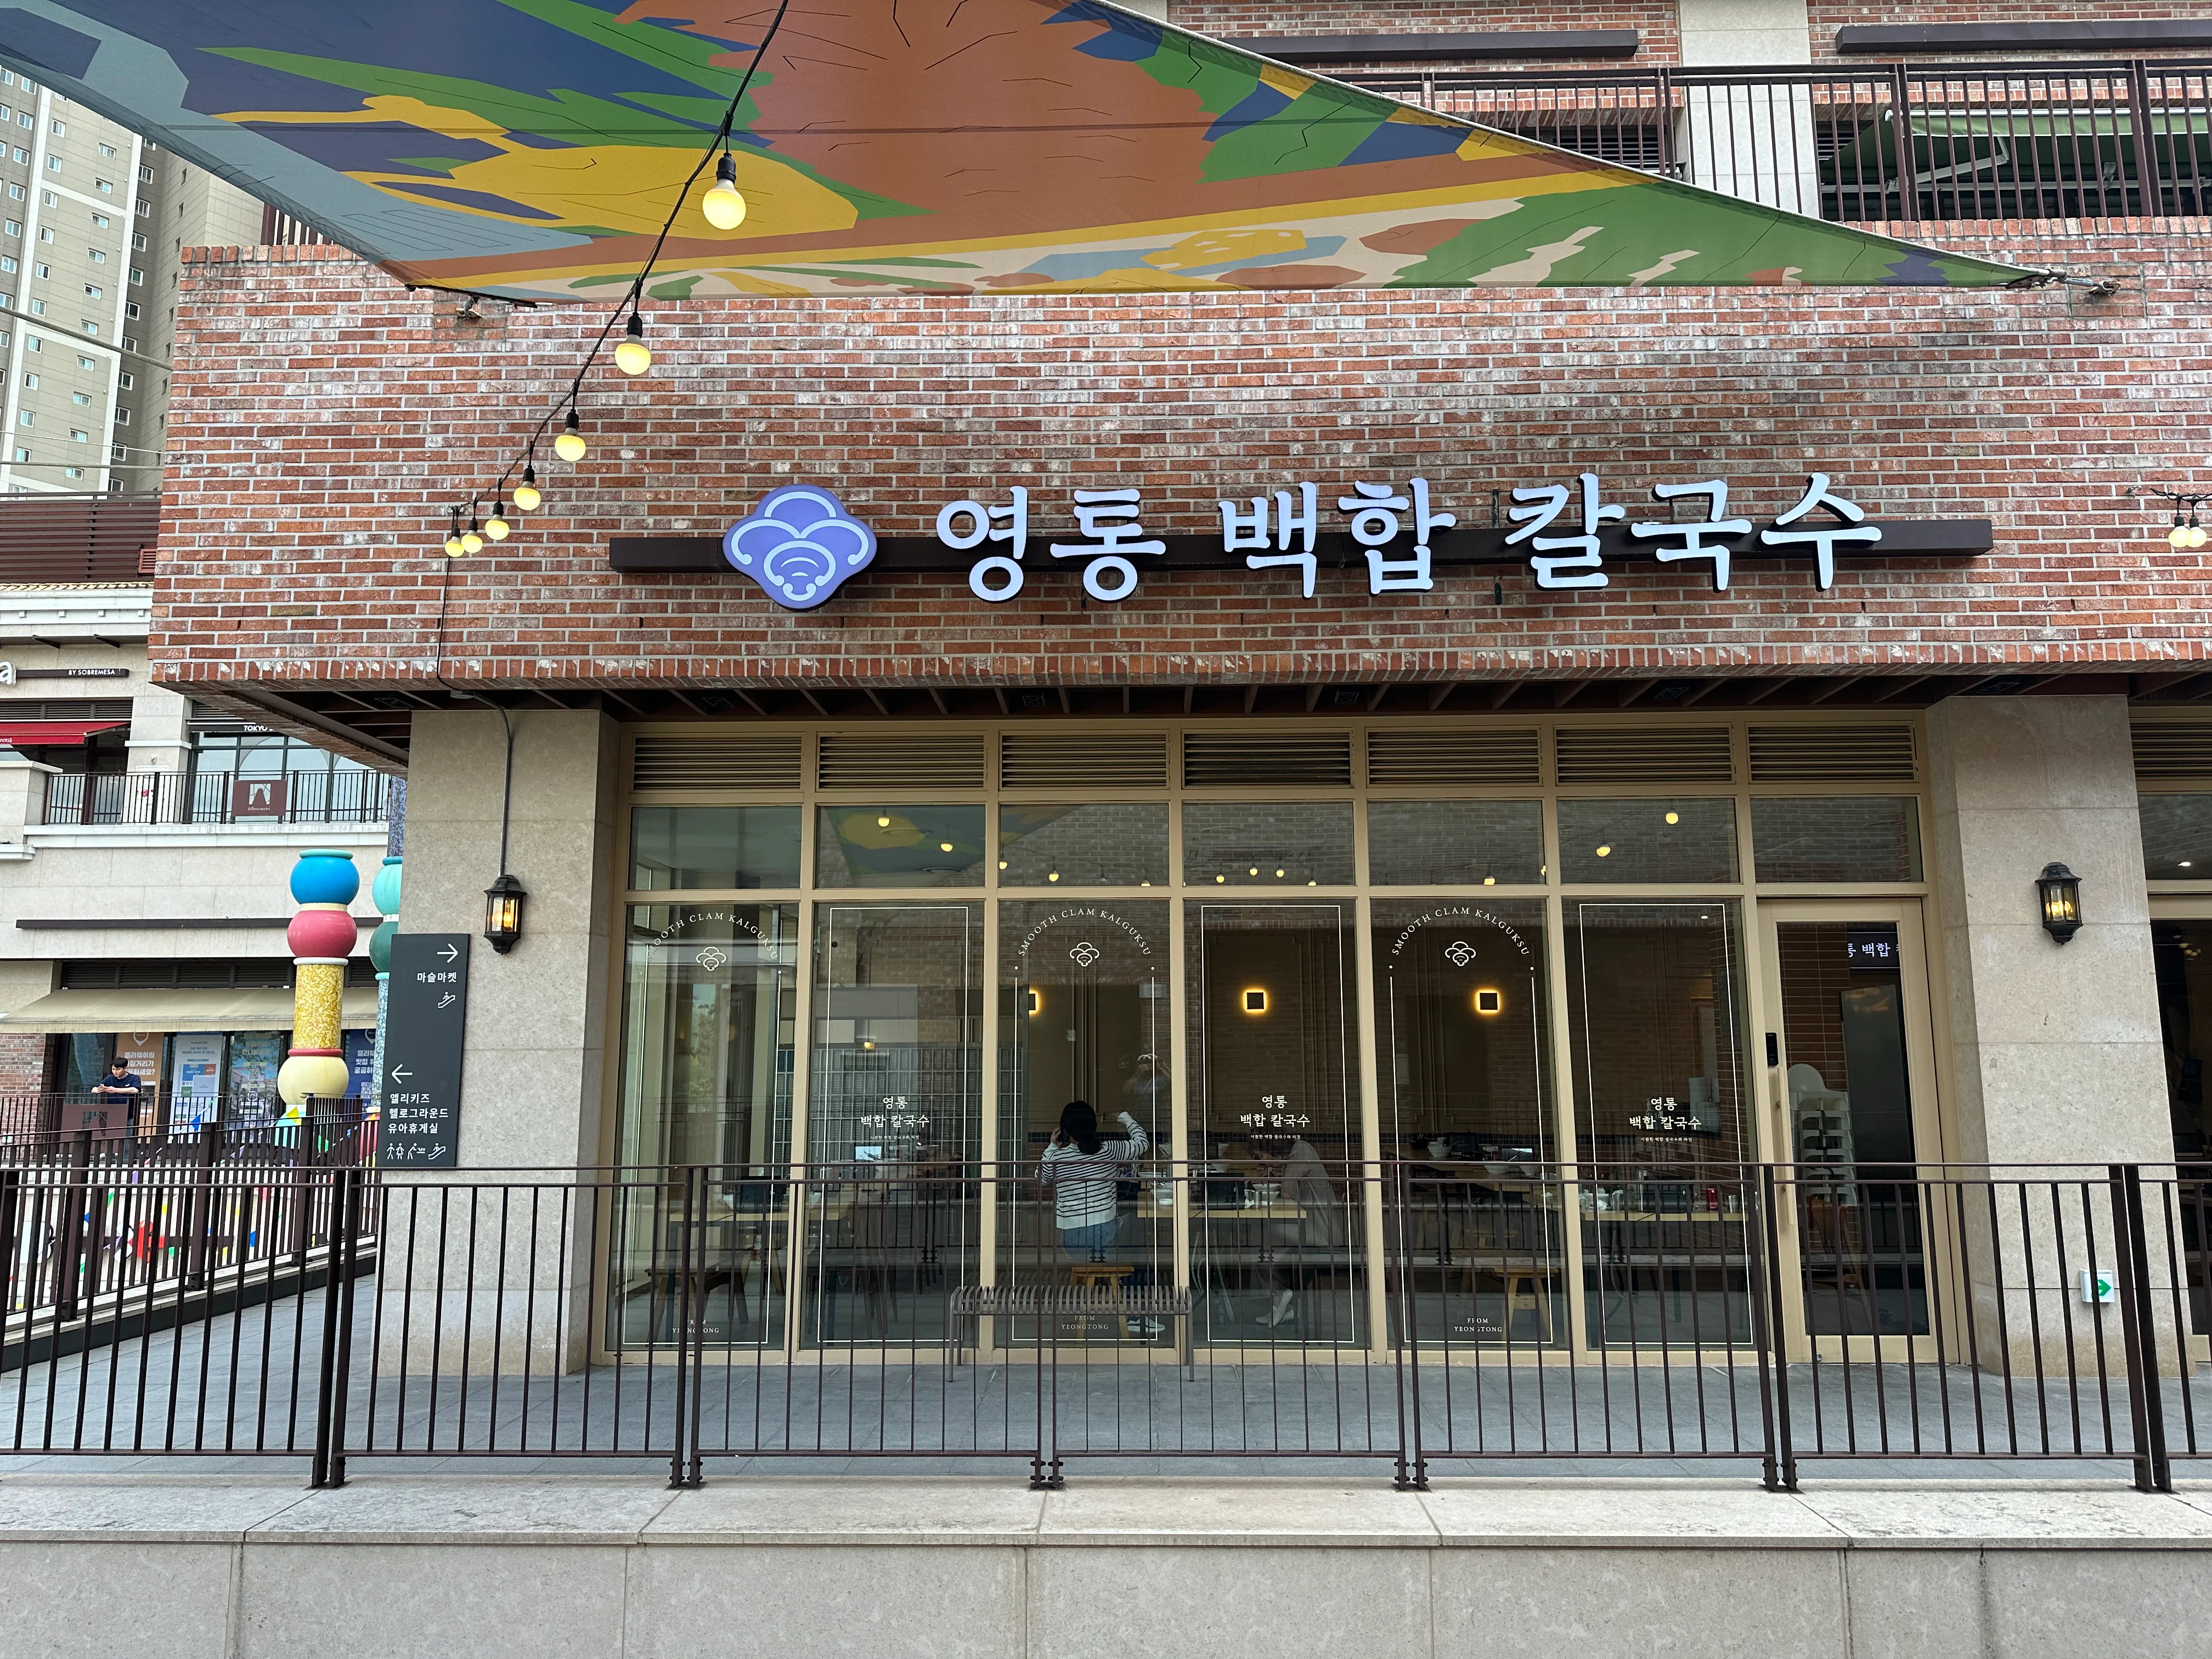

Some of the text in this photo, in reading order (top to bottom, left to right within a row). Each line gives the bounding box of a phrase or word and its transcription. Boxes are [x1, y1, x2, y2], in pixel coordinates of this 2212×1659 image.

[936, 472, 1882, 602] 영통 백합 칼국수
[689, 912, 724, 923] CLAM
[728, 914, 778, 960] KALGUKSU
[1018, 908, 1151, 956] SMOOTH CLAM KALGUKSU
[1392, 907, 1530, 955] SMOOTH CLAM KALGUKSU
[1861, 943, 1891, 957] 백합
[417, 972, 457, 983] 마슬마켓
[390, 1093, 430, 1104] 앨리키즈
[883, 1096, 908, 1109] 영통
[1262, 1094, 1288, 1109] 영통
[1651, 1097, 1678, 1111] 영통
[389, 1108, 448, 1119] 헬로그라운드
[1240, 1113, 1310, 1128] 백합 칼국수
[387, 1122, 438, 1134] 유아휴게실
[860, 1114, 929, 1128] 백합 칼국수
[1629, 1115, 1701, 1130] 백합 칼국수
